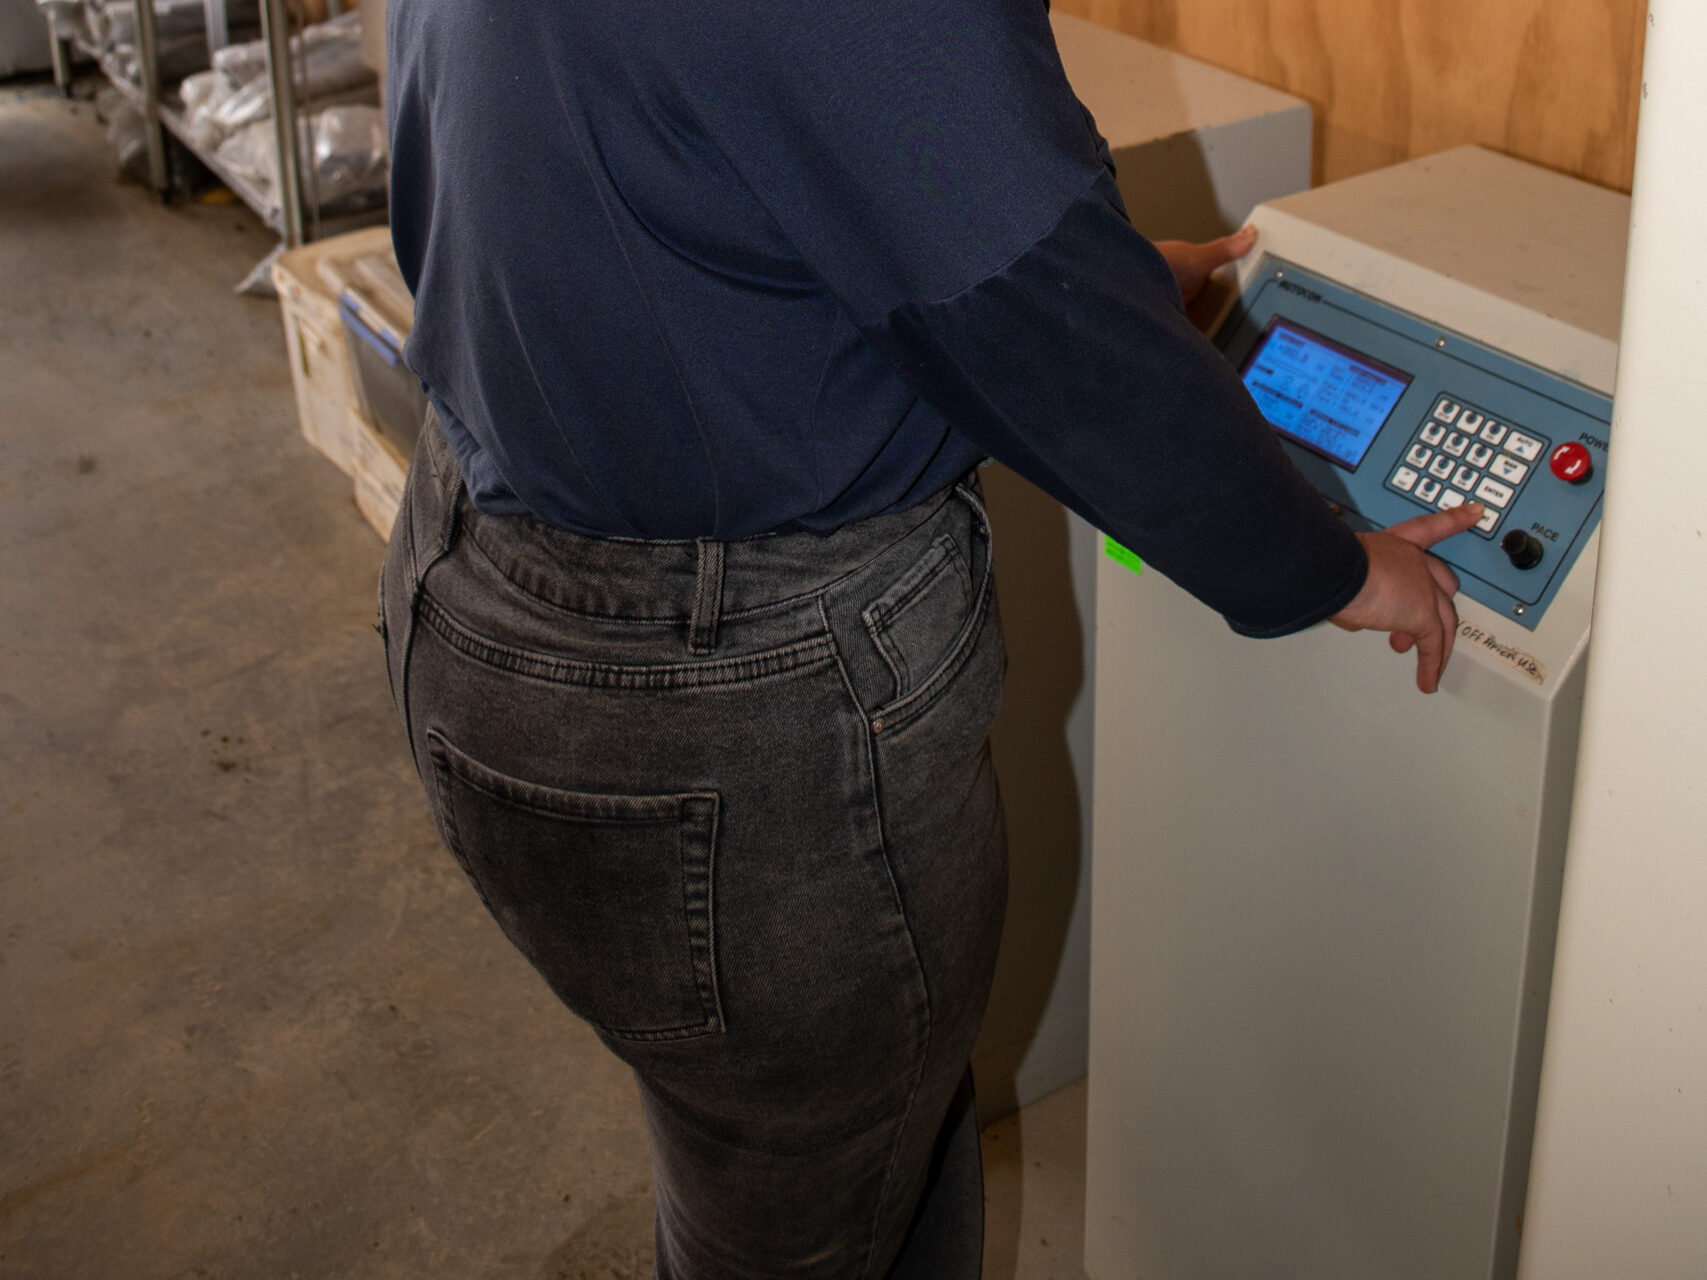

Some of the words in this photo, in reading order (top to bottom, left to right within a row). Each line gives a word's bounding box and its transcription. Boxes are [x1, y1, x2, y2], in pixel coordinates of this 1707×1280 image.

[1516, 436, 1534, 448] AUTO
[1578, 432, 1608, 452] POWE
[1503, 459, 1518, 470] MAN
[1484, 485, 1504, 498] ENTER
[1531, 522, 1560, 542] PACE
[1461, 625, 1485, 641] OFF
